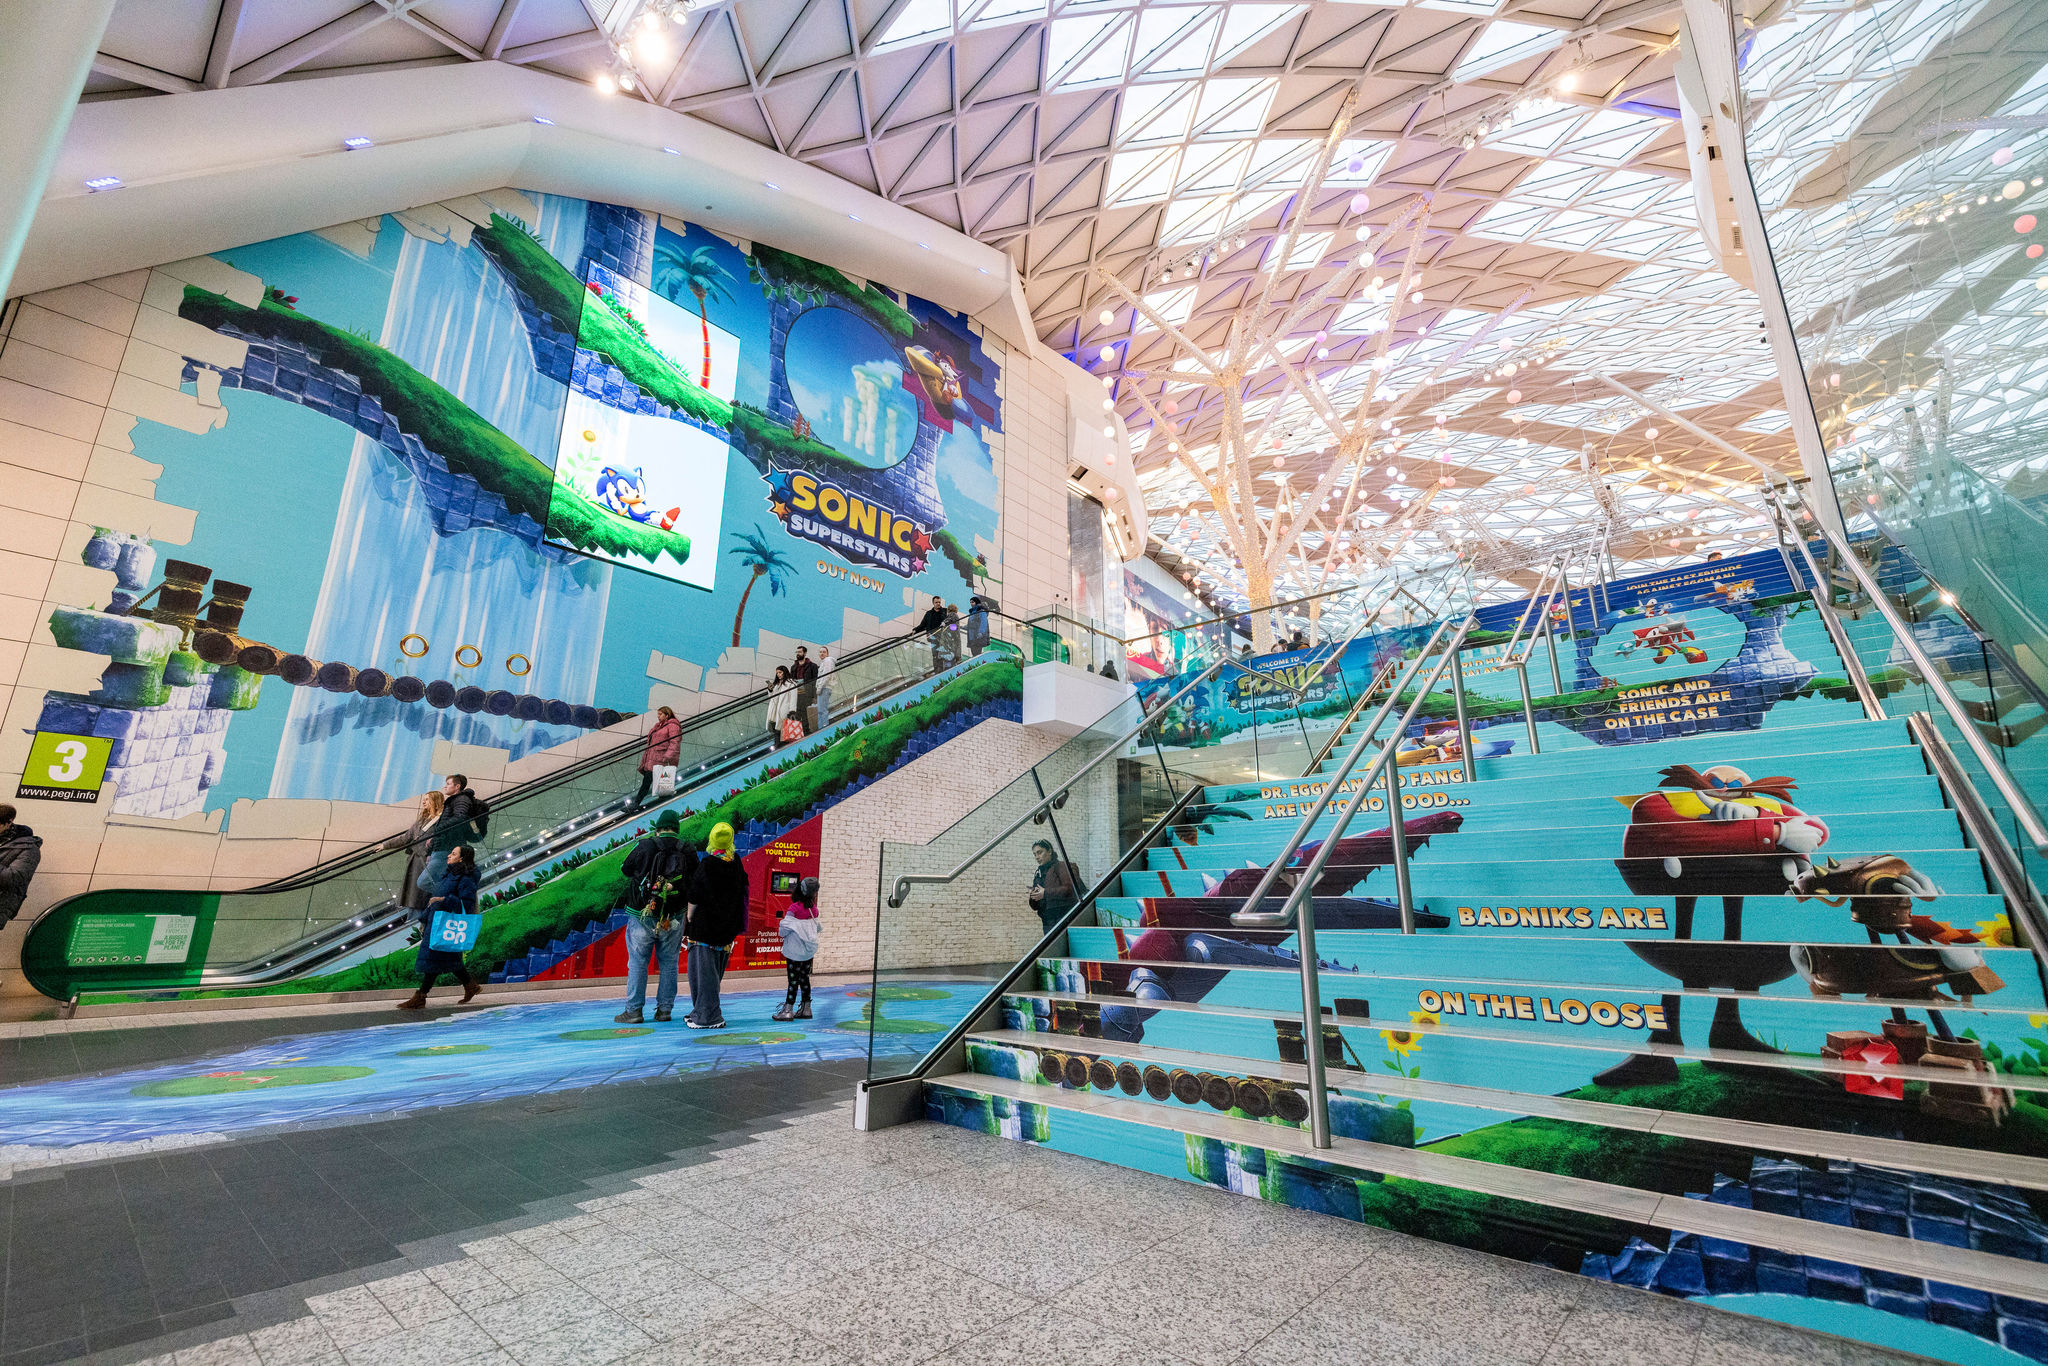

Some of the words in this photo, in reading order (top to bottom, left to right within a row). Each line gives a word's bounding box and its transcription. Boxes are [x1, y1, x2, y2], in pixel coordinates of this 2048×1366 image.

[792, 475, 913, 552] SONIC
[791, 514, 910, 573] SUPERSTARS
[816, 560, 848, 581] OUT
[849, 571, 885, 594] NOW
[1256, 659, 1289, 670] WELCOME
[1238, 663, 1324, 697] SONIC
[1617, 685, 1670, 701] SONIC
[1672, 680, 1710, 694] AND
[1619, 696, 1691, 714] FRIENDS
[1694, 691, 1732, 704] ARE
[1604, 717, 1631, 730] ON
[1632, 712, 1667, 726] THE
[1669, 706, 1720, 722] CASE
[48, 740, 87, 782] 3
[20, 788, 96, 800] www.pegi.info
[1260, 787, 1287, 800] DR.
[1409, 769, 1464, 787] FANG
[1264, 804, 1297, 819] ARE
[1328, 799, 1350, 814] TO
[1356, 797, 1384, 812] NO
[1400, 792, 1470, 809] OOD...
[1457, 907, 1593, 928] BADNIKS
[1598, 907, 1668, 930] ARE
[1418, 989, 1467, 1015] ON
[1468, 992, 1536, 1021] THE
[1540, 997, 1670, 1032] LOOSE
